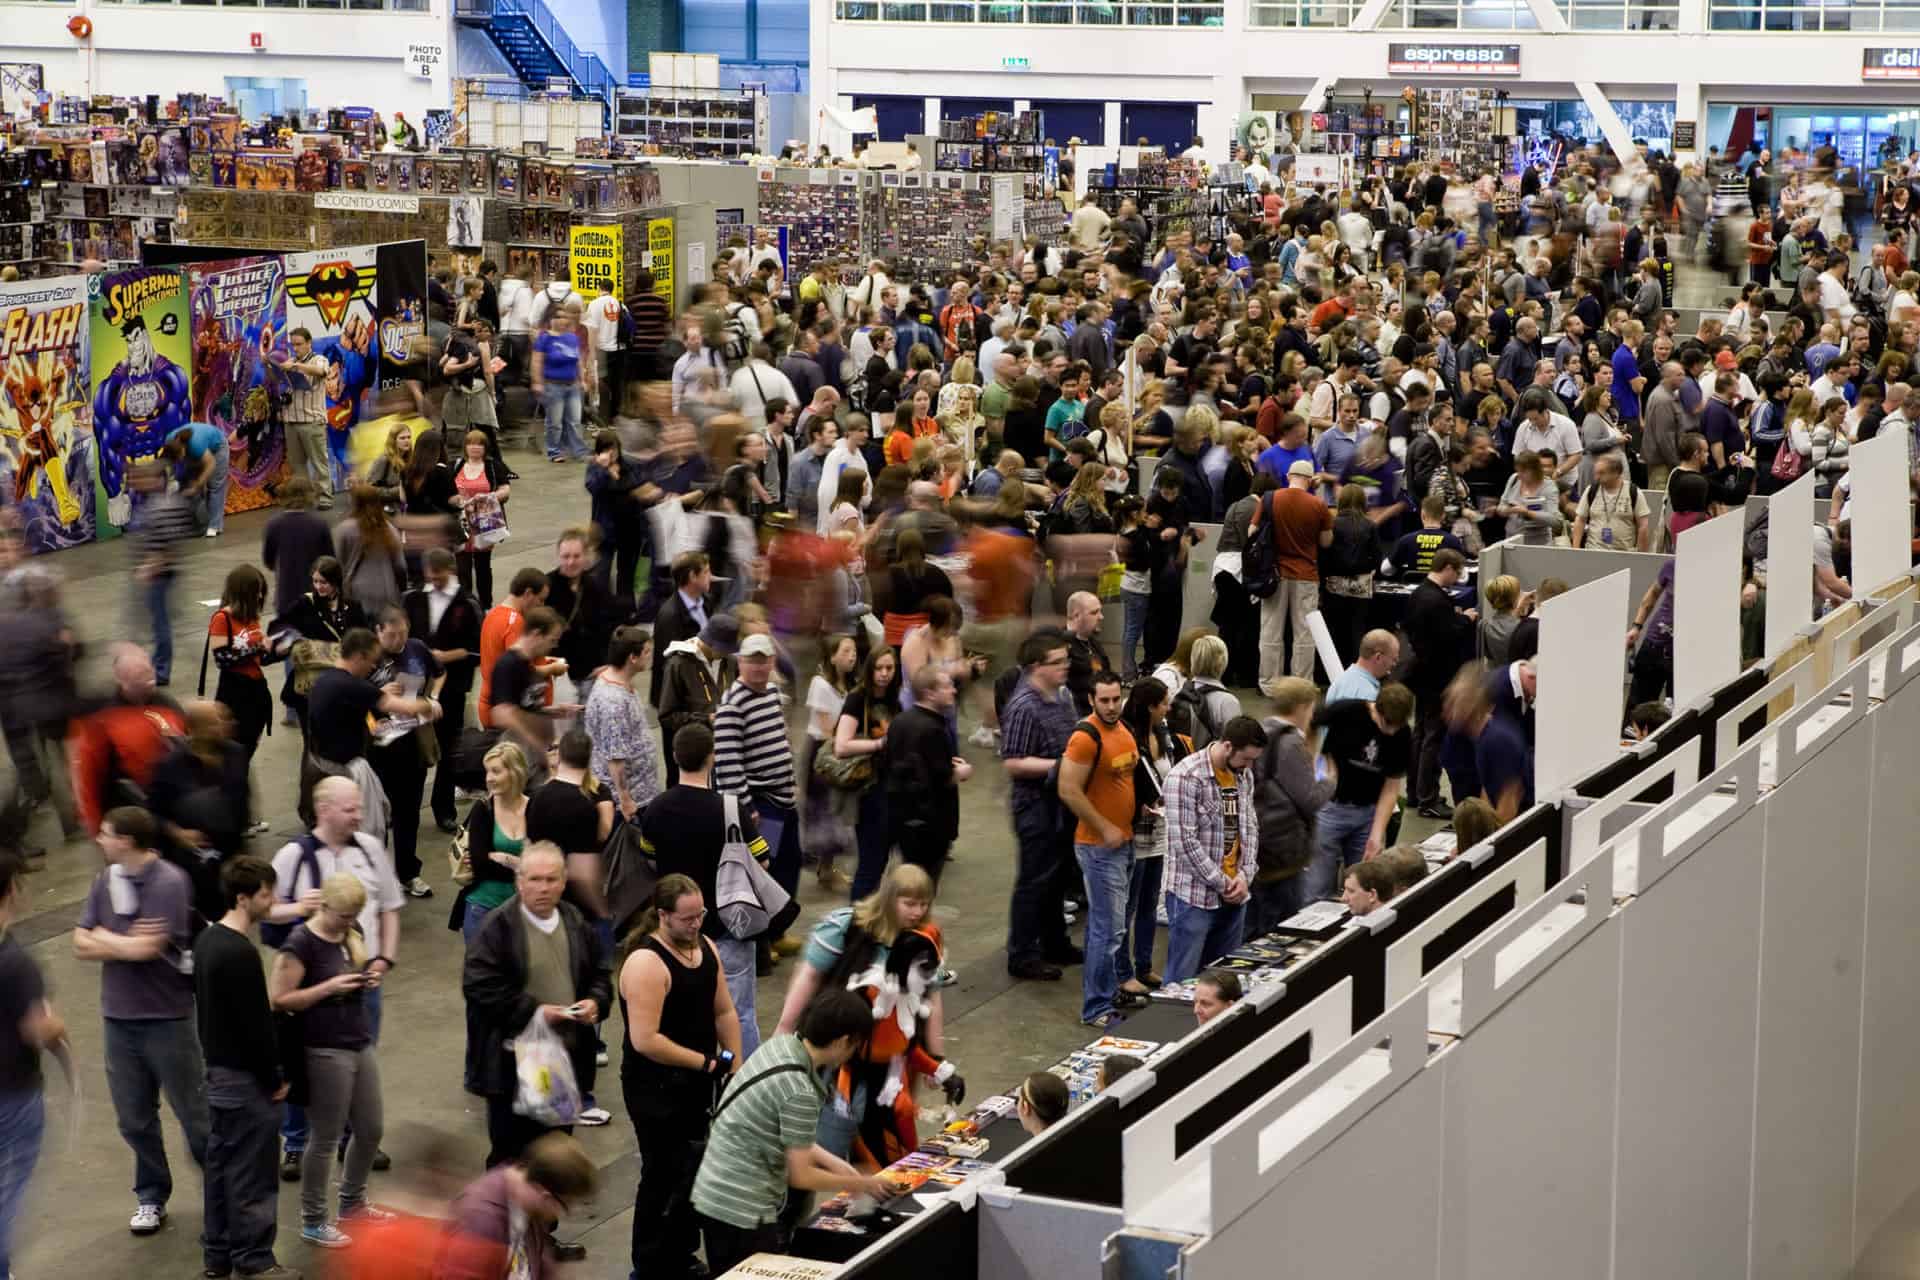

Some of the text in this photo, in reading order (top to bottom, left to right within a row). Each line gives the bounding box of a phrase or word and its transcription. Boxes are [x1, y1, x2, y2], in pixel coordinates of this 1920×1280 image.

[409, 44, 442, 55] PHOTO
[1404, 47, 1504, 64] espresso
[1883, 48, 1920, 66] del
[412, 55, 439, 64] AREA
[421, 64, 431, 76] B
[315, 194, 417, 210] INCOGNITO COMICS
[575, 231, 614, 247] AUTOGRAPH
[574, 247, 614, 259] HOLDERS
[652, 254, 670, 268] SOLD
[576, 262, 611, 276] SOLD
[219, 268, 273, 288] JUSTICE
[577, 277, 600, 291] HER
[213, 281, 264, 302] LEAGUE
[110, 273, 181, 328] SUPERMAN
[0, 302, 84, 360] FLASH
